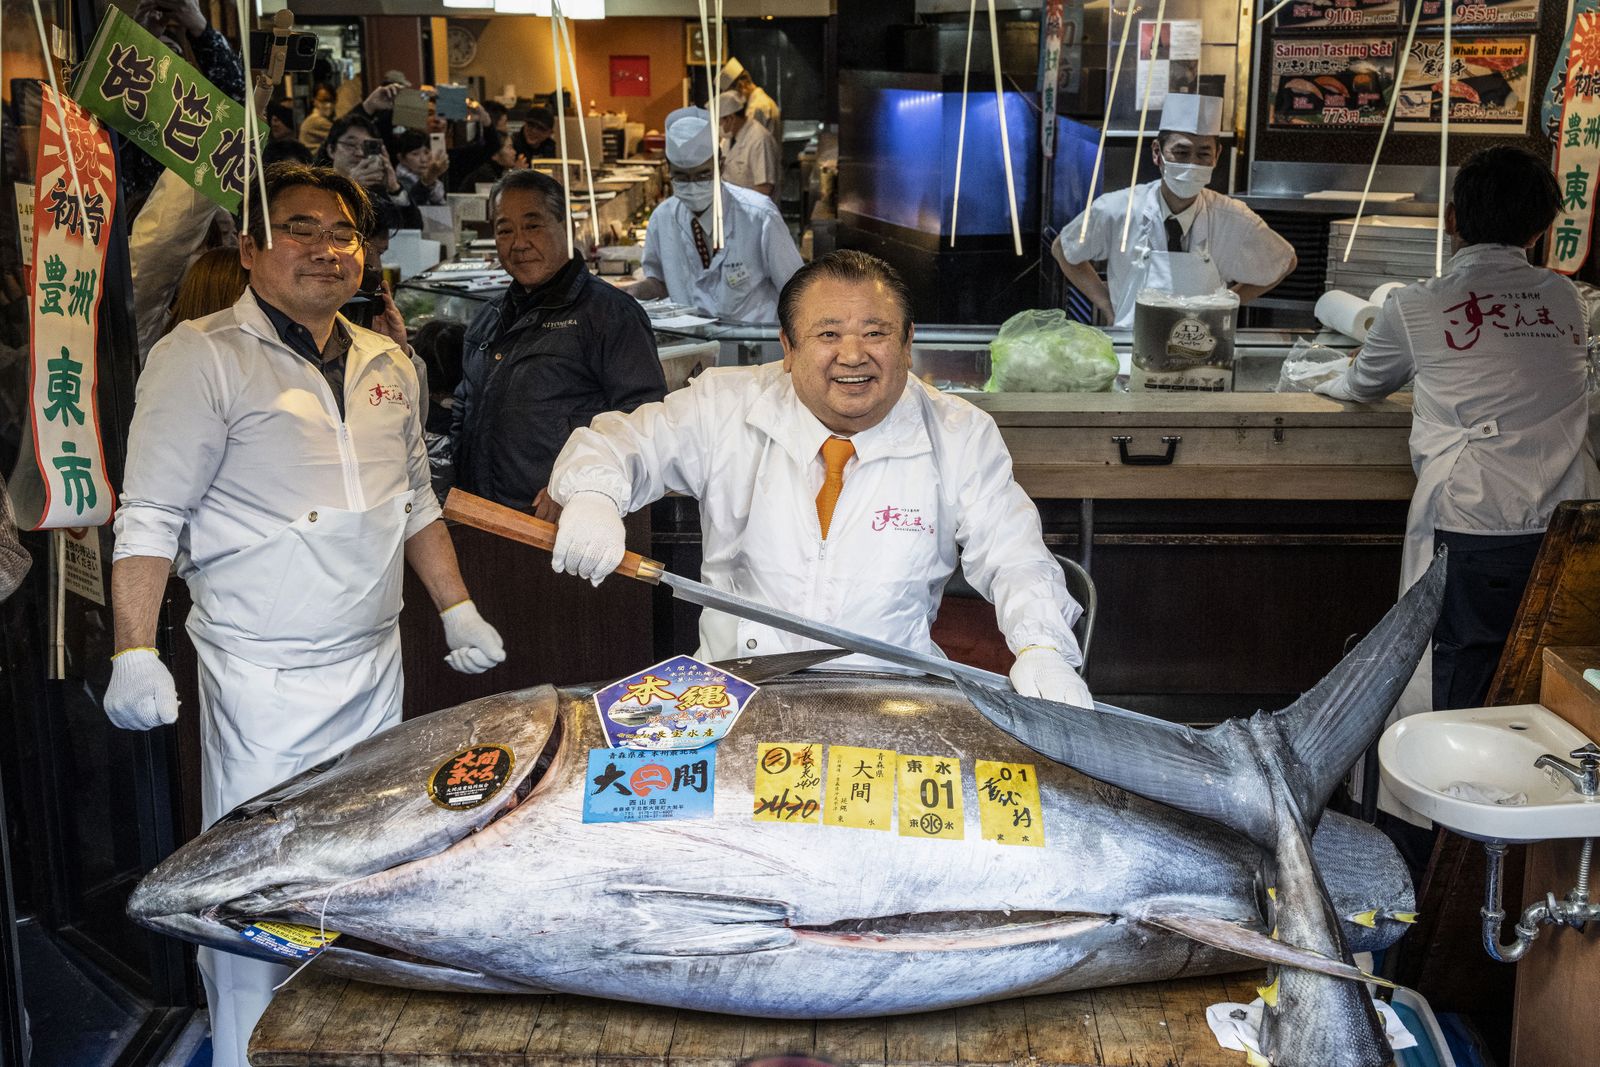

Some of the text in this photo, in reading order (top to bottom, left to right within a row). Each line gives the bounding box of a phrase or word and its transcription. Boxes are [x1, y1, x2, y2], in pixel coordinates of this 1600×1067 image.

[1325, 8, 1362, 24] 910円
[1456, 4, 1498, 22] 955円
[1276, 42, 1392, 58] Salmon Tasting Set
[1453, 46, 1523, 56] Whale tail meat
[1323, 107, 1359, 124] 773円
[1564, 112, 1600, 149] 豊洲
[1556, 163, 1590, 263] 東市
[39, 254, 97, 325] 豊洲
[42, 346, 98, 516] 東市
[619, 674, 731, 712] 本縄
[851, 759, 875, 804] 大間
[1000, 767, 1028, 782] 01
[920, 778, 955, 810] 01
